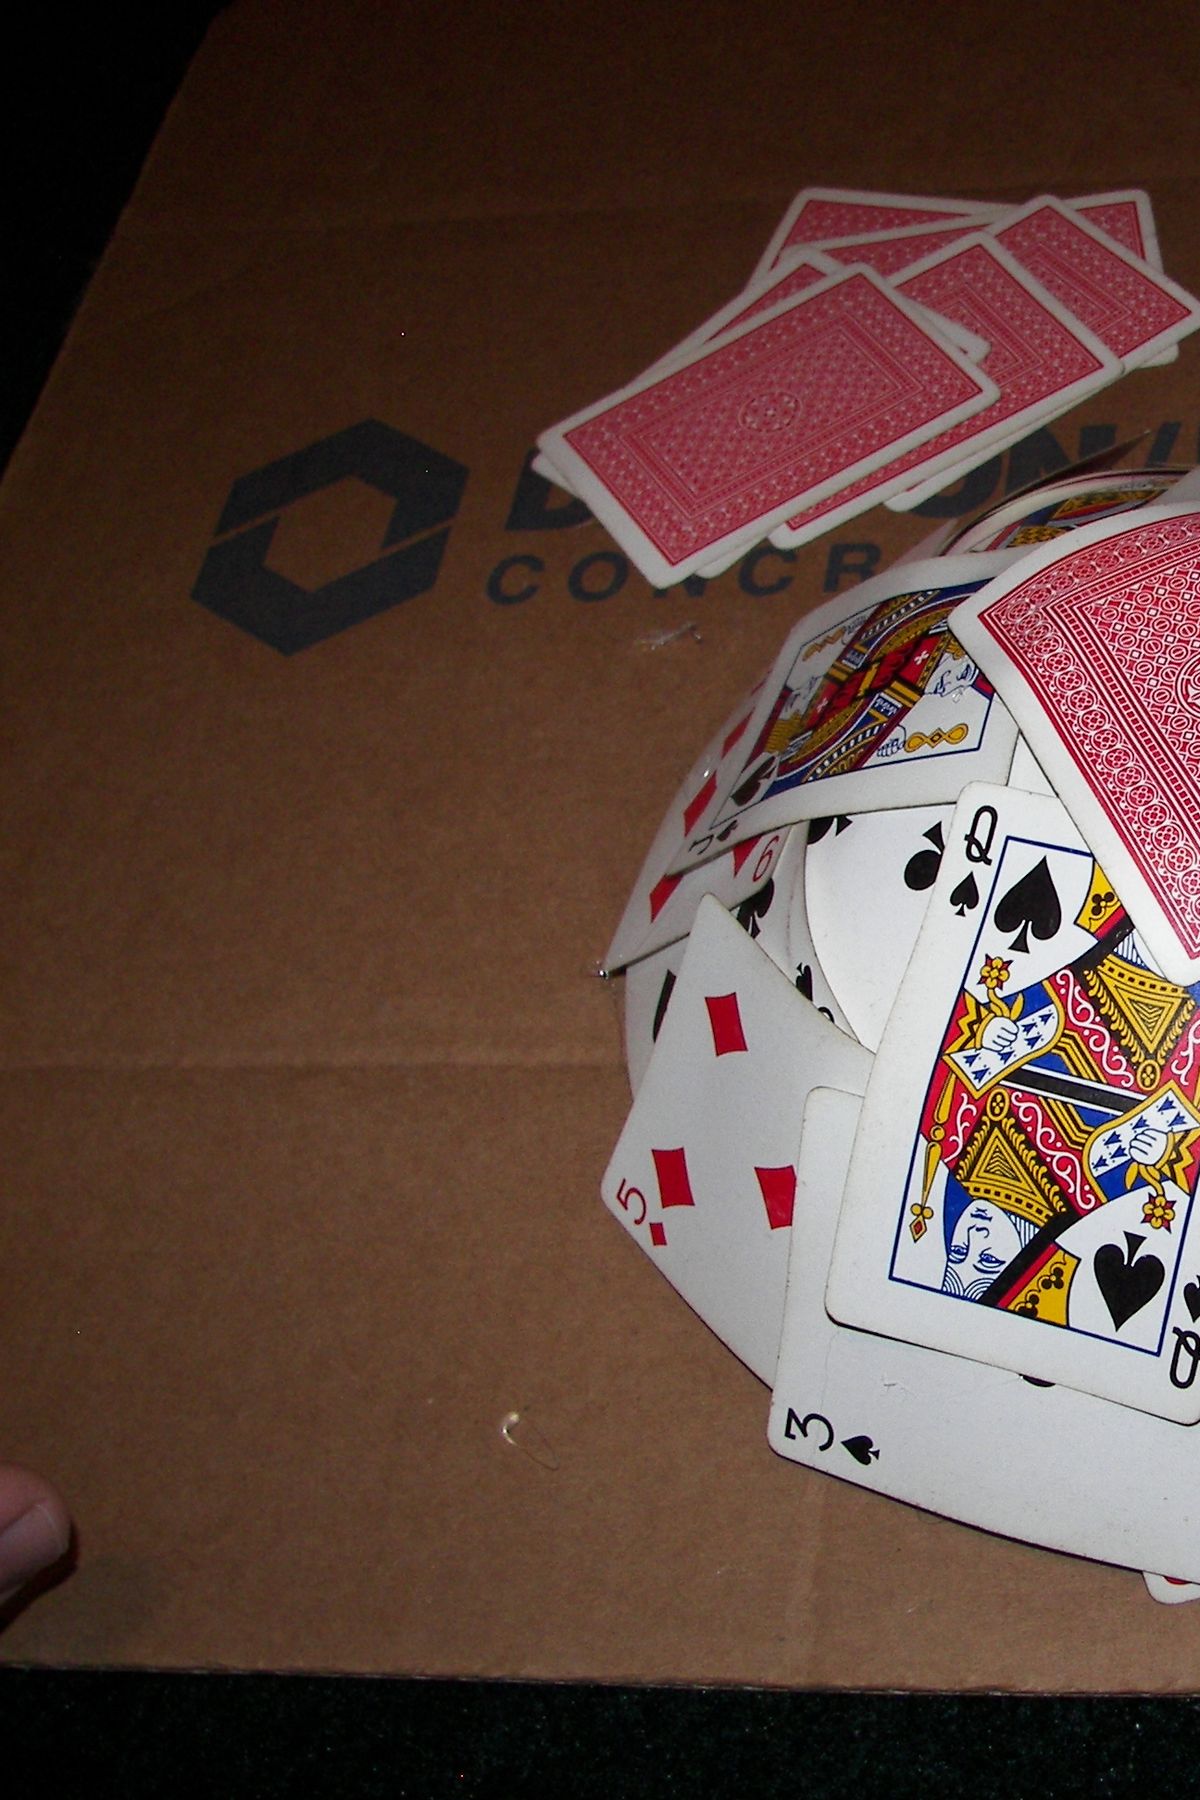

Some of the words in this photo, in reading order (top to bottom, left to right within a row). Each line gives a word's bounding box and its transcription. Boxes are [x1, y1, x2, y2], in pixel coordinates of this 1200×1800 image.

[964, 804, 998, 866] Q
[615, 1177, 648, 1227] 5
[784, 1407, 835, 1452] 3
